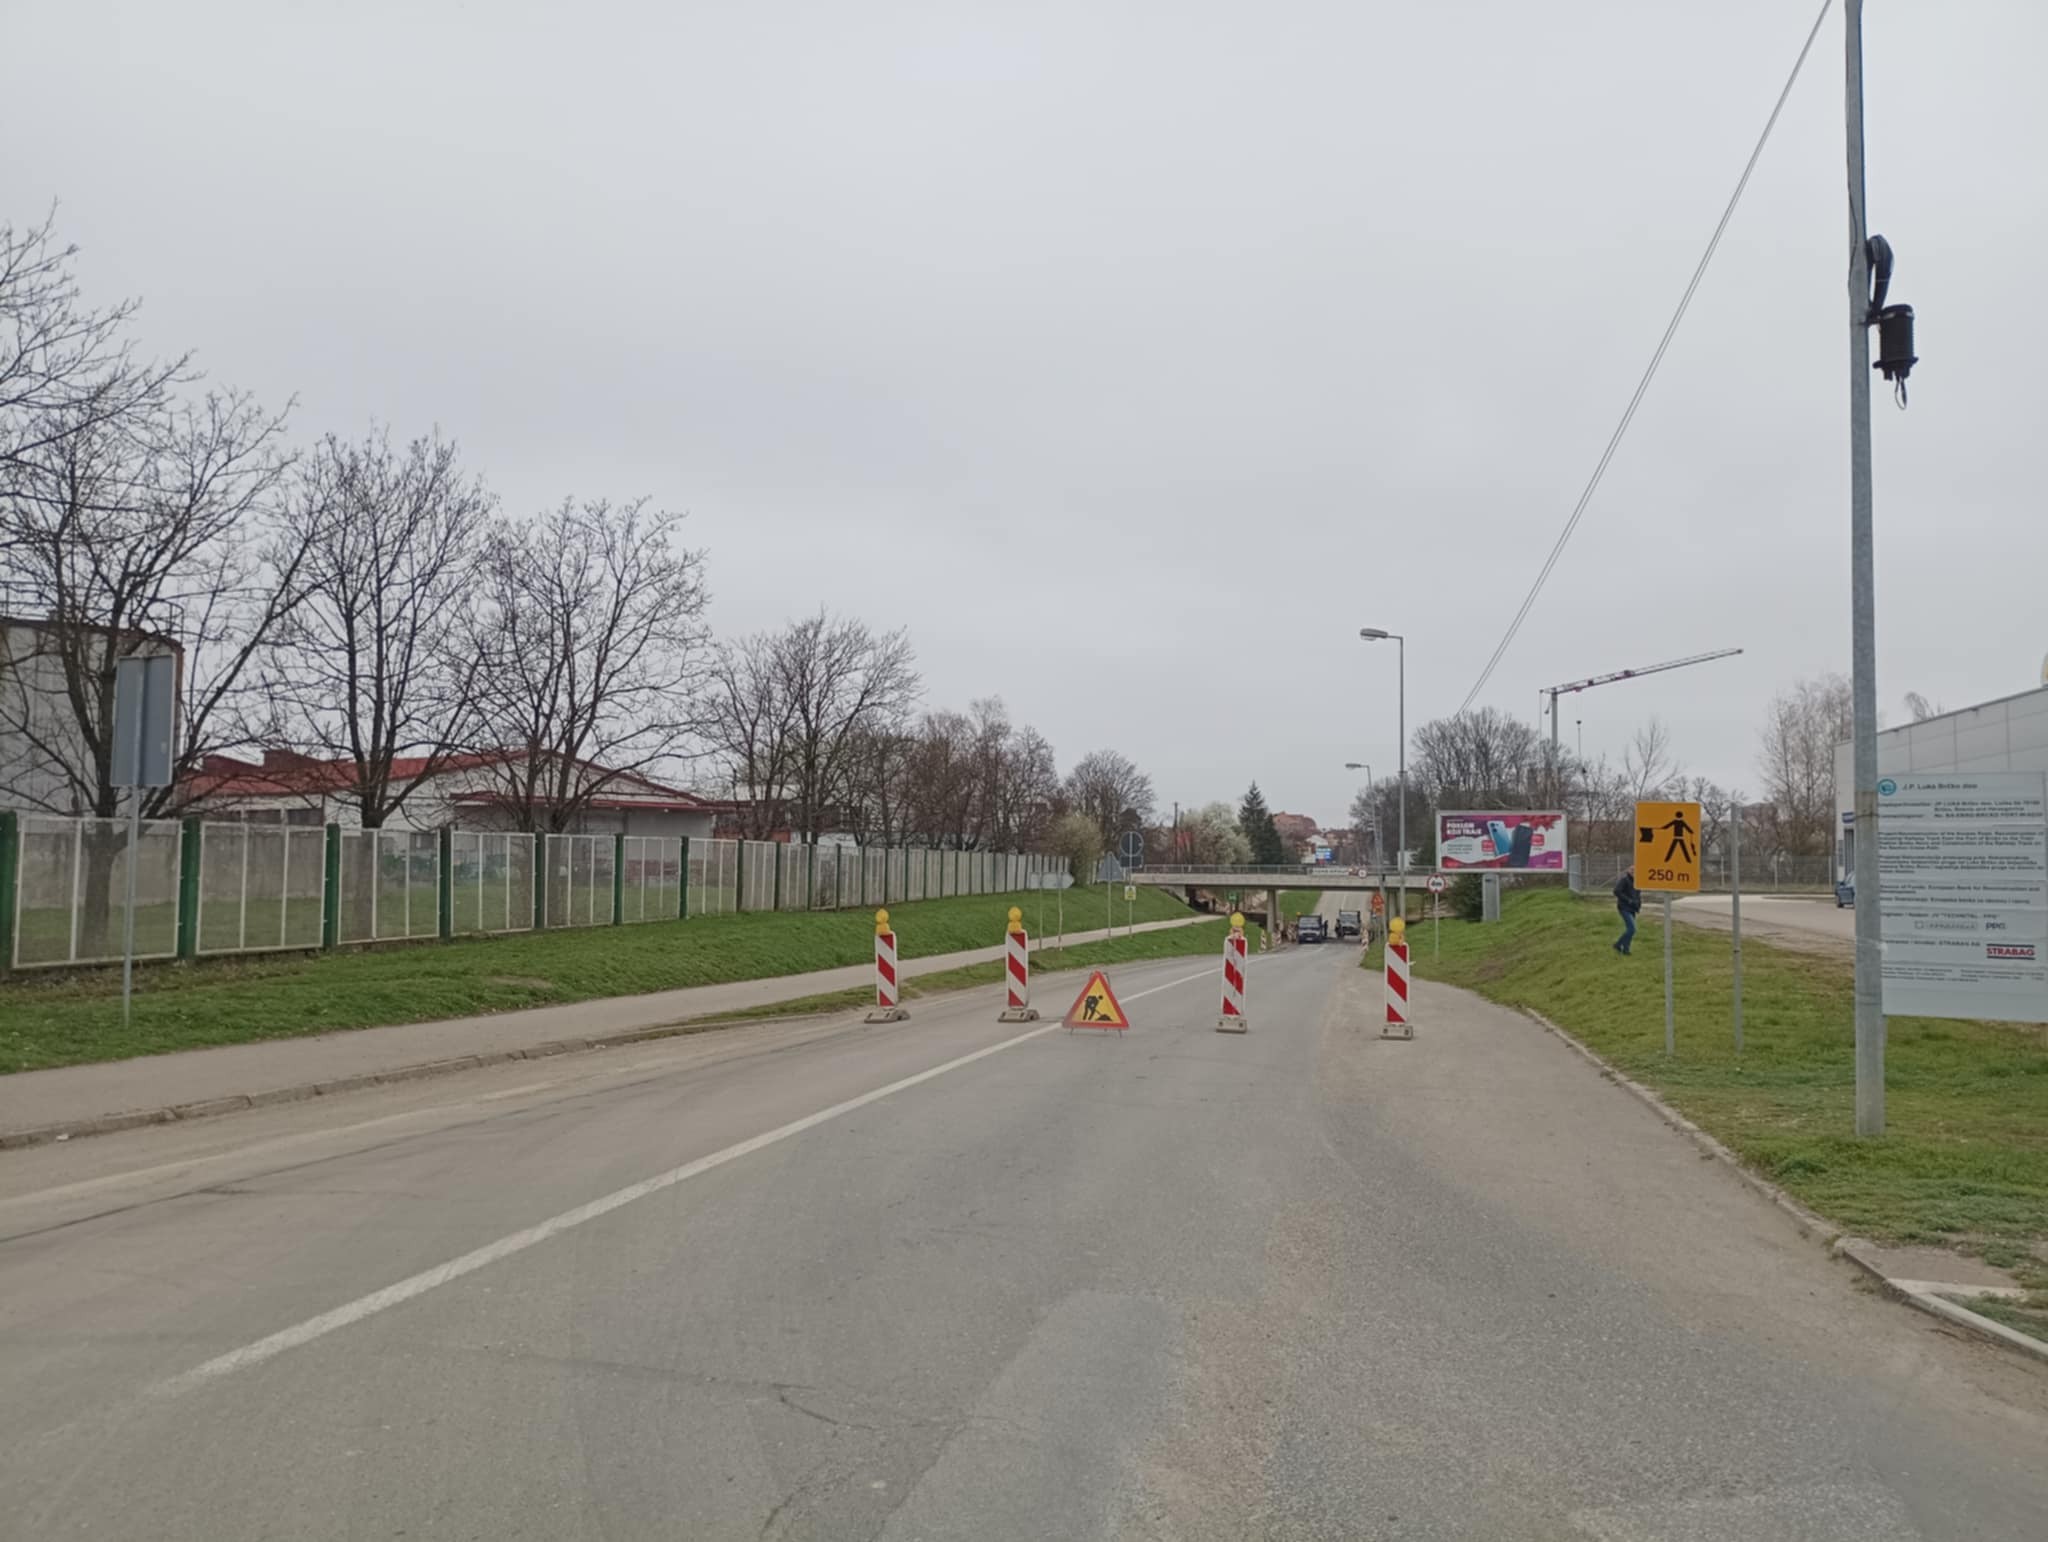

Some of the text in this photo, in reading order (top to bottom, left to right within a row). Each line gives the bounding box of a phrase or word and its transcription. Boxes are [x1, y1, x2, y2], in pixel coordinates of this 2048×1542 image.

[1648, 869, 1690, 882] 250 m
[1986, 948, 2035, 956] STRABAG
